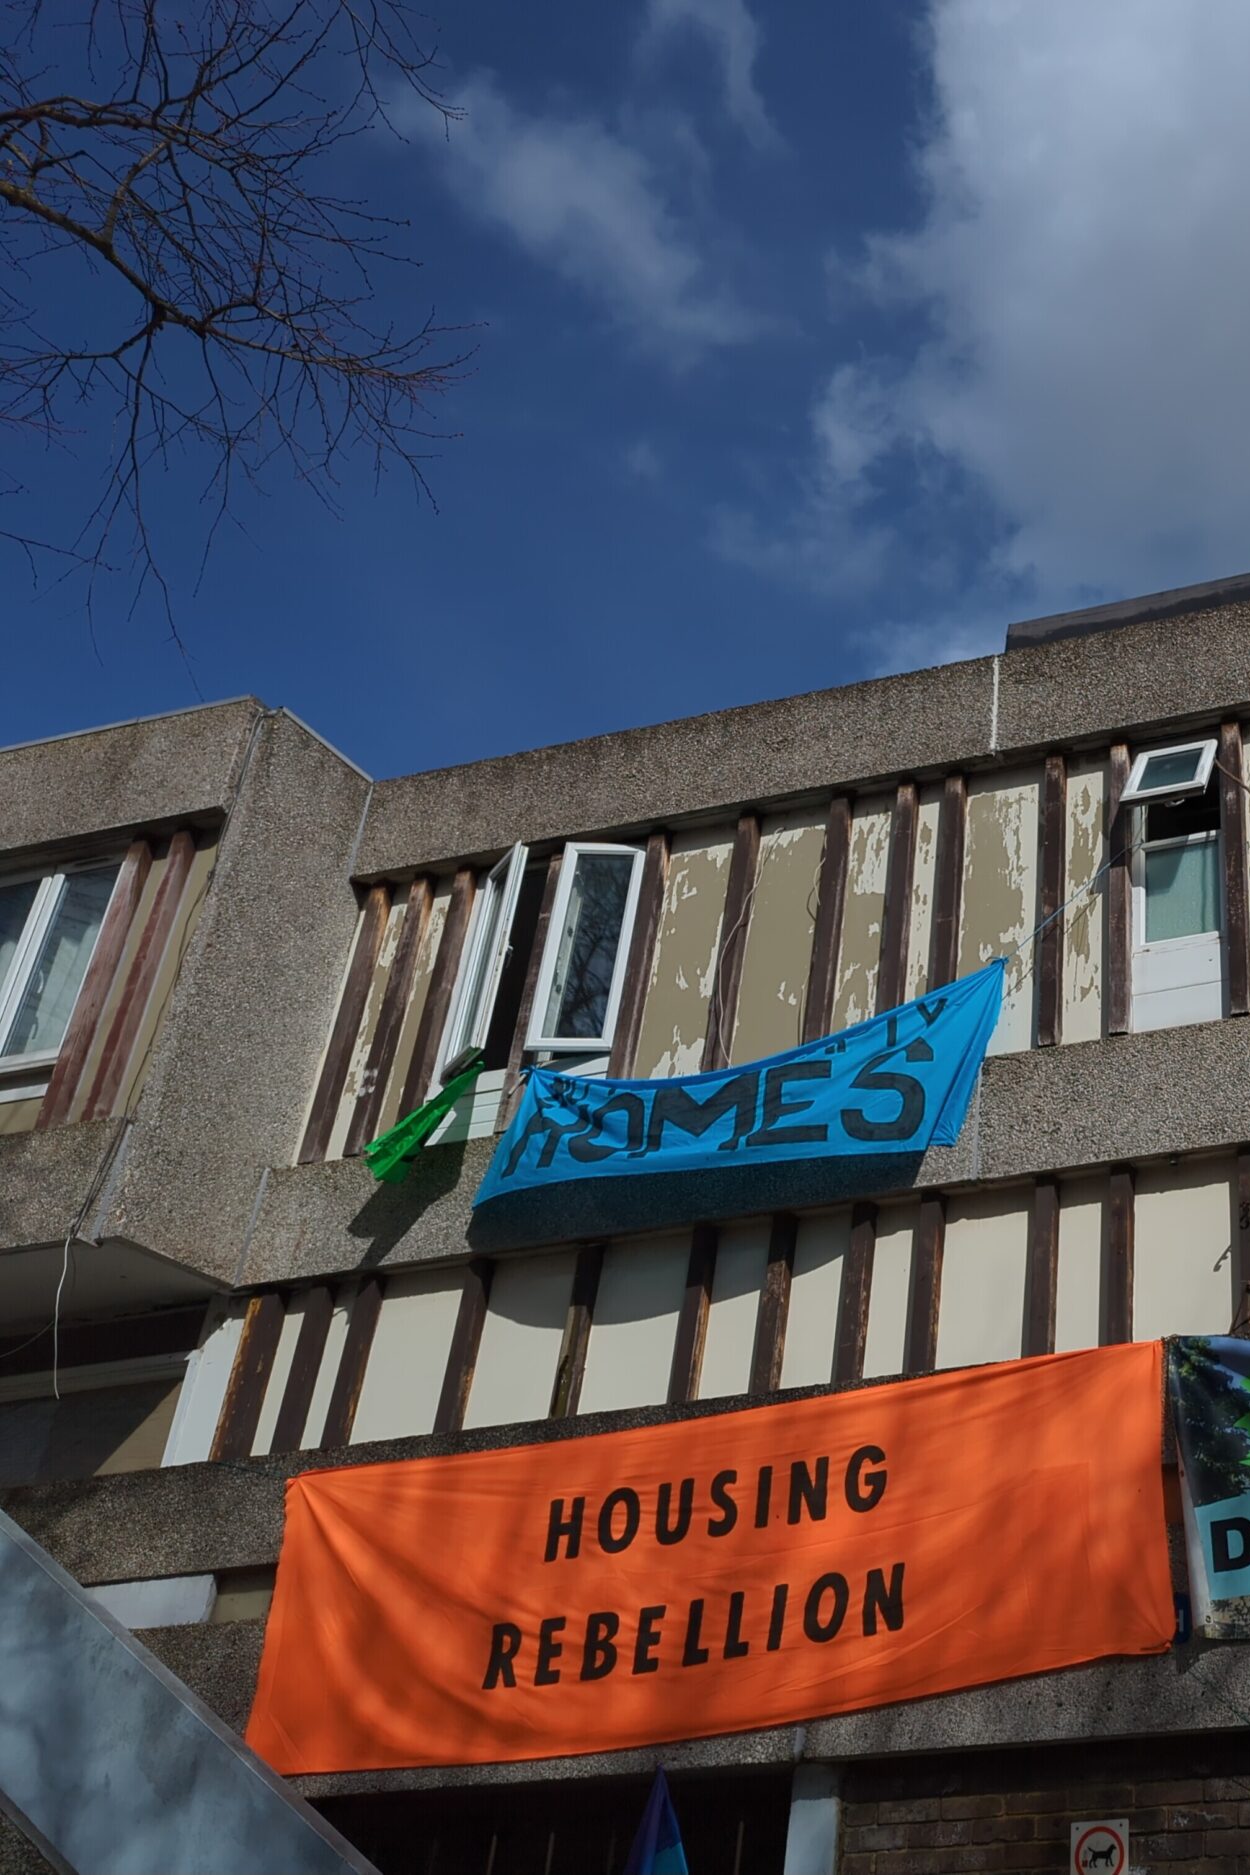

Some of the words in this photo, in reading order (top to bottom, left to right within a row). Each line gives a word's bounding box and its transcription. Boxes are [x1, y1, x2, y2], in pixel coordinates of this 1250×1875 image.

[501, 1036, 934, 1179] HOMES
[544, 1445, 888, 1562] HOUSING
[482, 1562, 906, 1691] REBELLION
